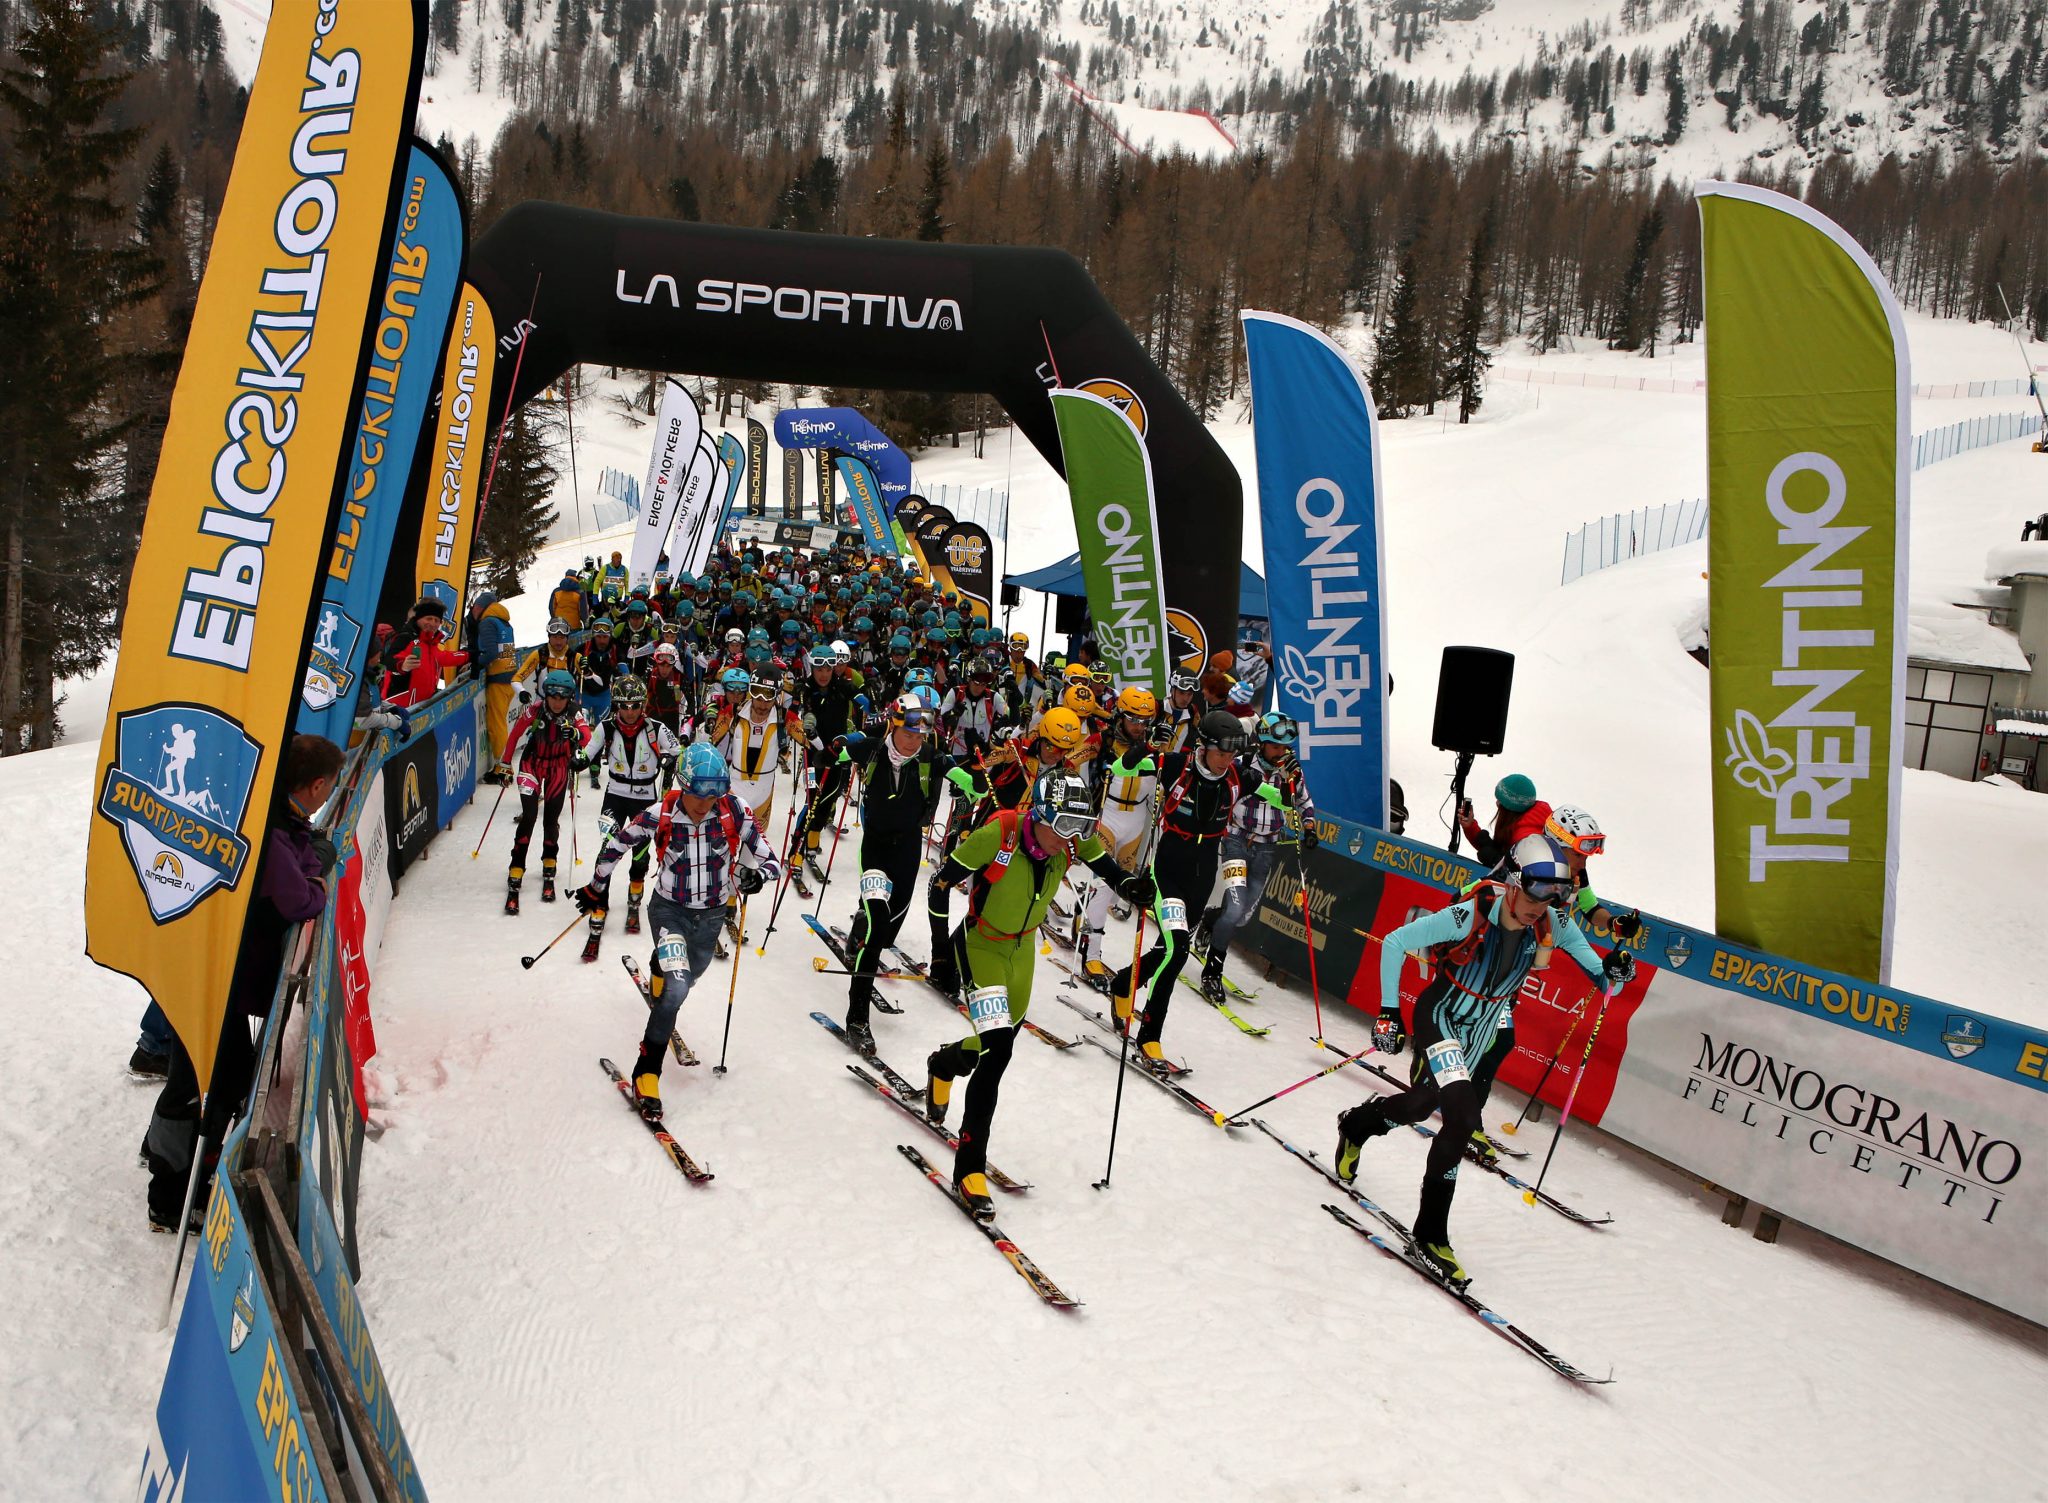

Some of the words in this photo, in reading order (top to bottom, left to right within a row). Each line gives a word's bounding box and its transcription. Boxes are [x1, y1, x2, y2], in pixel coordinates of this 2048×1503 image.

[616, 269, 680, 308] LA
[789, 421, 836, 435] TRENTINO
[855, 442, 889, 452] TRENTINO
[880, 482, 908, 493] TRENTINO
[1097, 502, 1157, 691] TRENTINO
[1296, 476, 1371, 762] TRENTINO
[1748, 449, 1875, 884] TRENTINO
[1563, 809, 1580, 831] CAMP
[861, 877, 887, 890] 1008
[1372, 840, 1468, 889] EPICSKITOUR
[975, 997, 1009, 1017] 1003
[1709, 949, 1900, 1034] EPICSKITOUR
[1443, 1065, 1464, 1075] PALZER
[1693, 1031, 2022, 1186] MONOGRANO
[1681, 1076, 2003, 1226] FELICETTI
